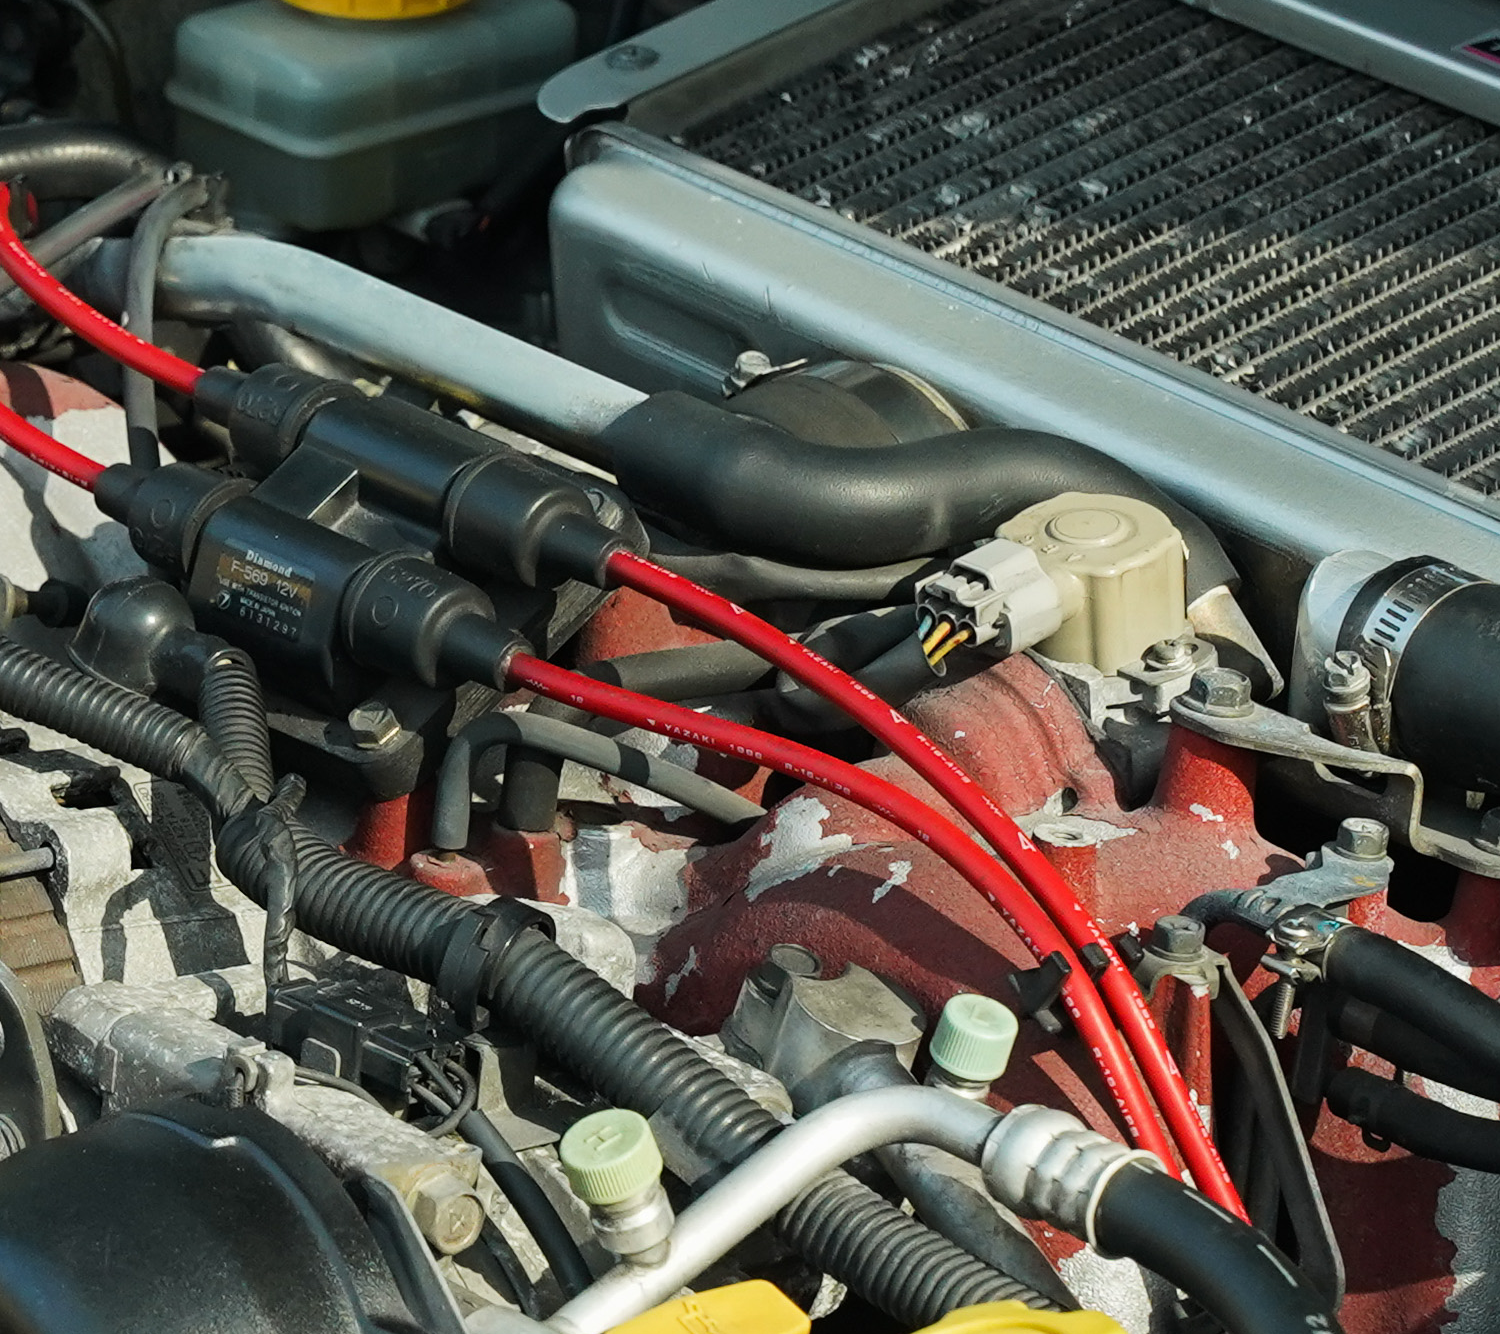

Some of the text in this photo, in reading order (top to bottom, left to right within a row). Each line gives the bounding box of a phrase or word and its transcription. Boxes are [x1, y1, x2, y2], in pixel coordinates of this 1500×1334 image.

[230, 559, 298, 599] F-569 12V
[243, 548, 294, 577] Diamond
[800, 644, 841, 677] YAZAKI
[662, 719, 717, 747] YAZAKI
[1002, 906, 1046, 964] YAZAKI
